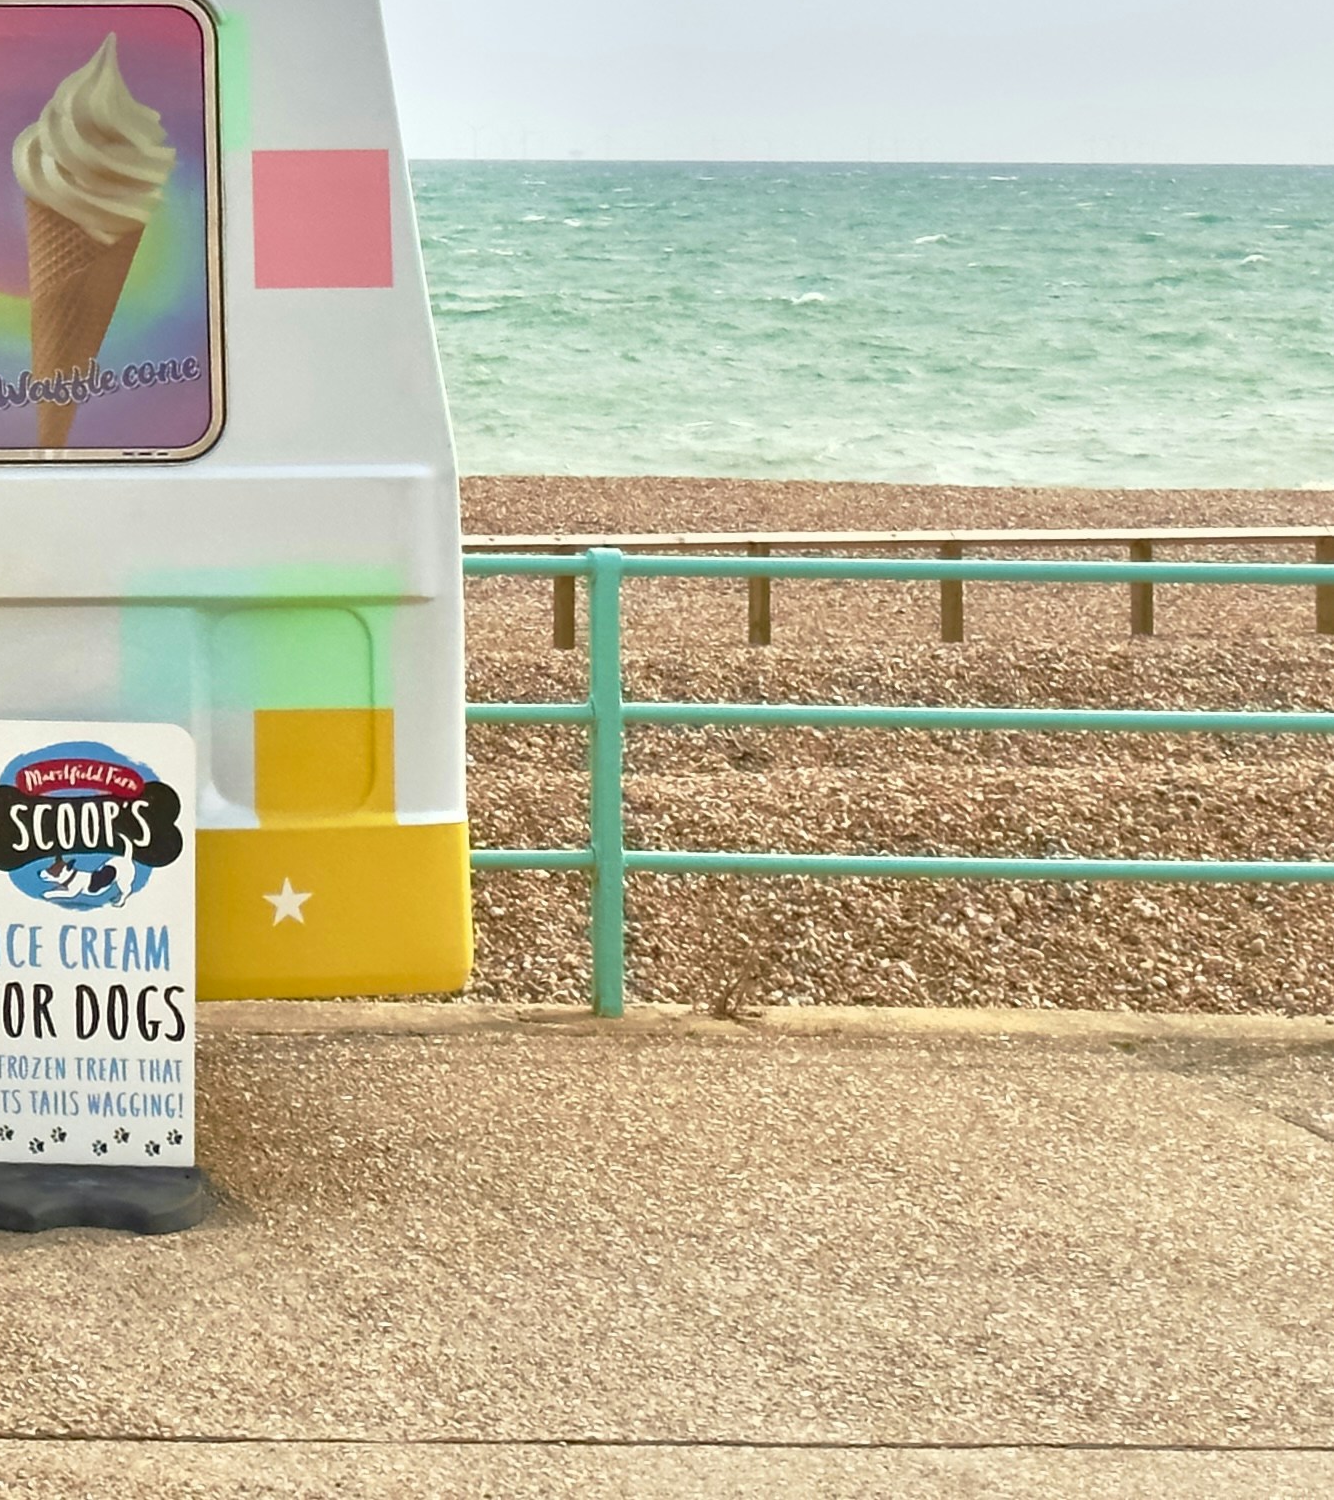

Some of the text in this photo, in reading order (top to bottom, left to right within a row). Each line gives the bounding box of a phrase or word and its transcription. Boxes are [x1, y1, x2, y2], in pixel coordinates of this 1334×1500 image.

[121, 355, 201, 390] cone
[9, 799, 152, 852] SCOOP'S
[58, 924, 171, 972] CREAM
[75, 984, 186, 1043] DOGS
[75, 1056, 130, 1083] TREAT
[138, 1058, 183, 1084] THAT
[29, 1090, 80, 1117] TAILS
[87, 1091, 184, 1120] WAGGING!
